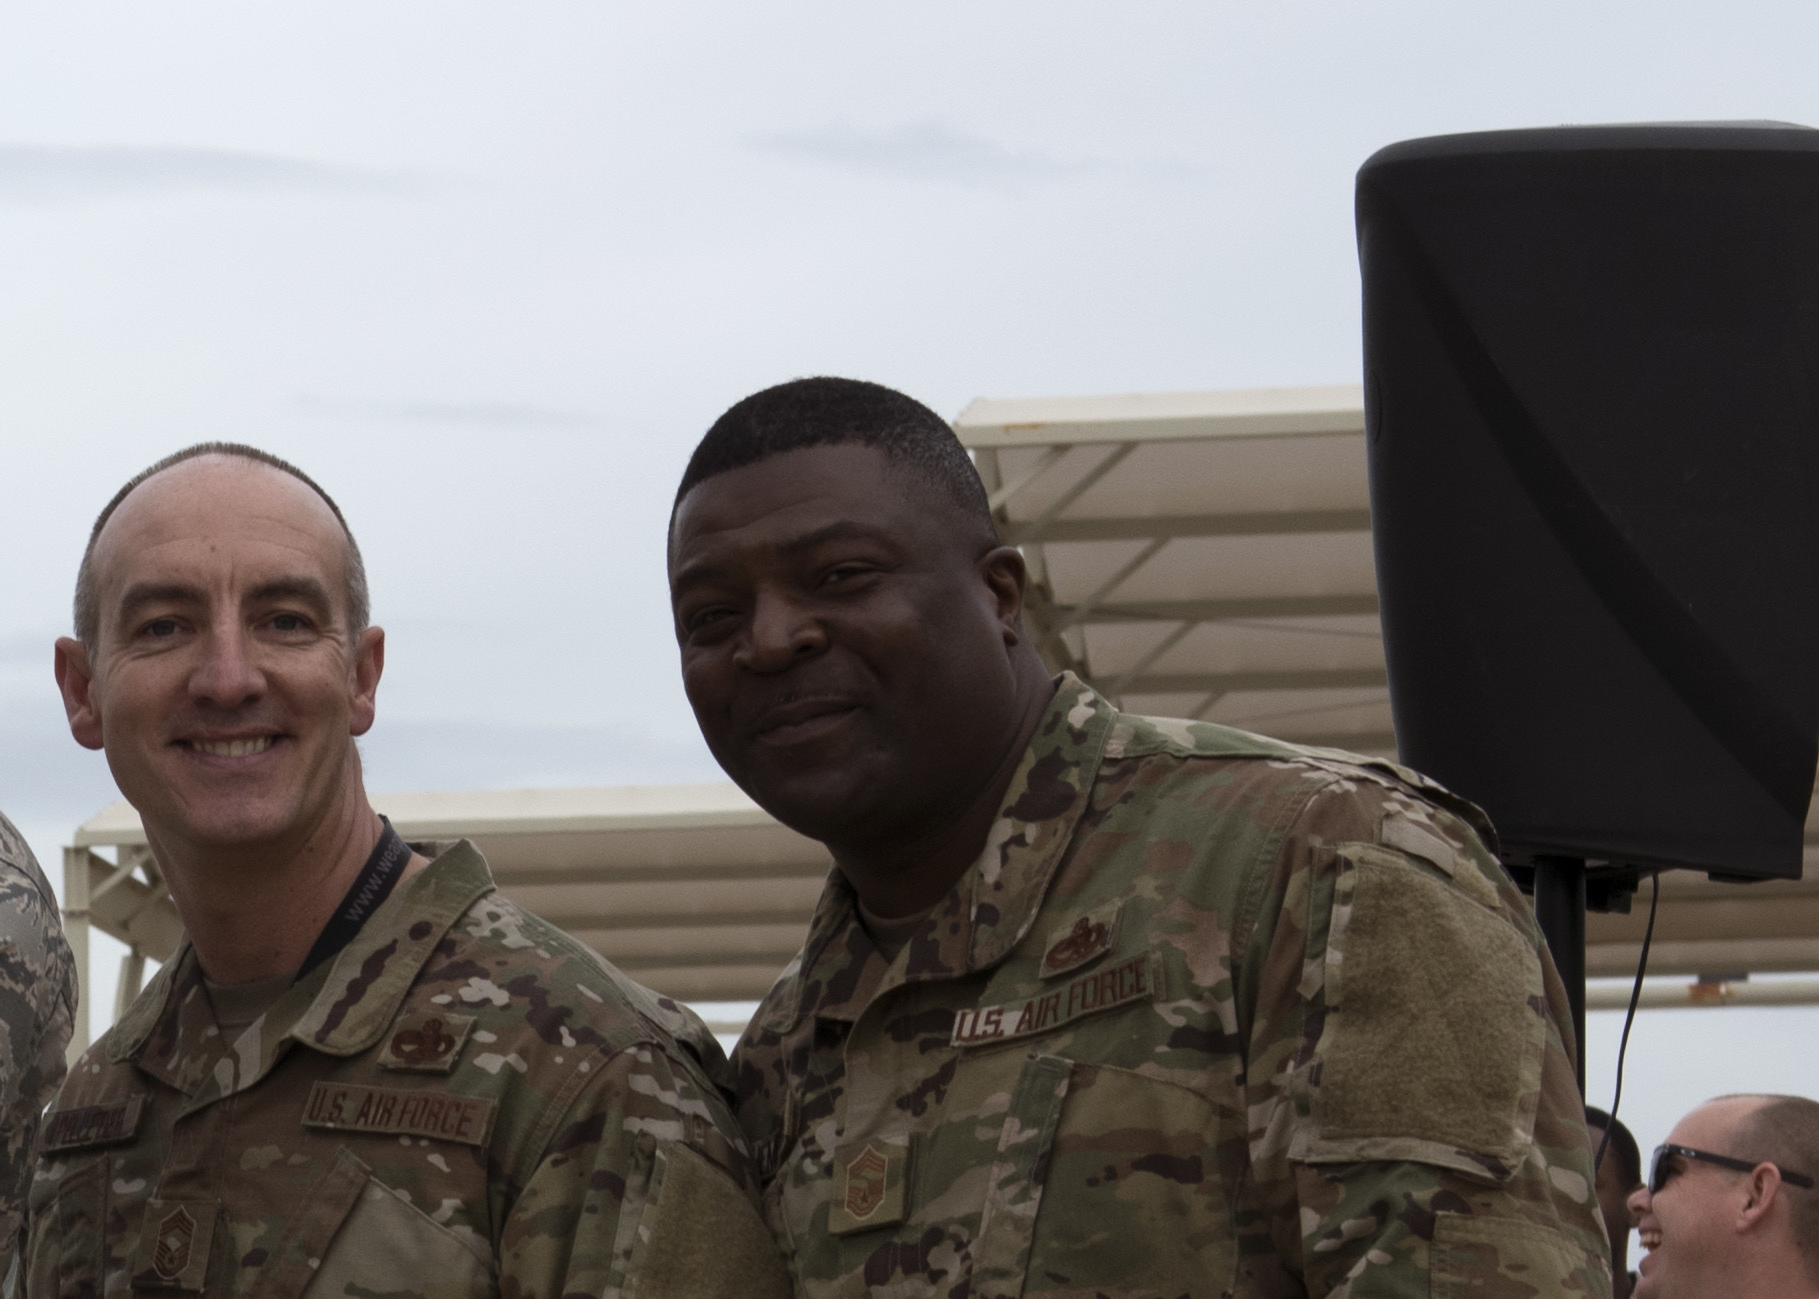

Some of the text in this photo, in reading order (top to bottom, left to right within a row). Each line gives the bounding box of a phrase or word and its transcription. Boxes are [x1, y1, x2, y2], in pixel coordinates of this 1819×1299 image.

[955, 957, 1148, 1042] U.S. AIR FORCE
[309, 1087, 478, 1137] U.S. AIR FORCE
